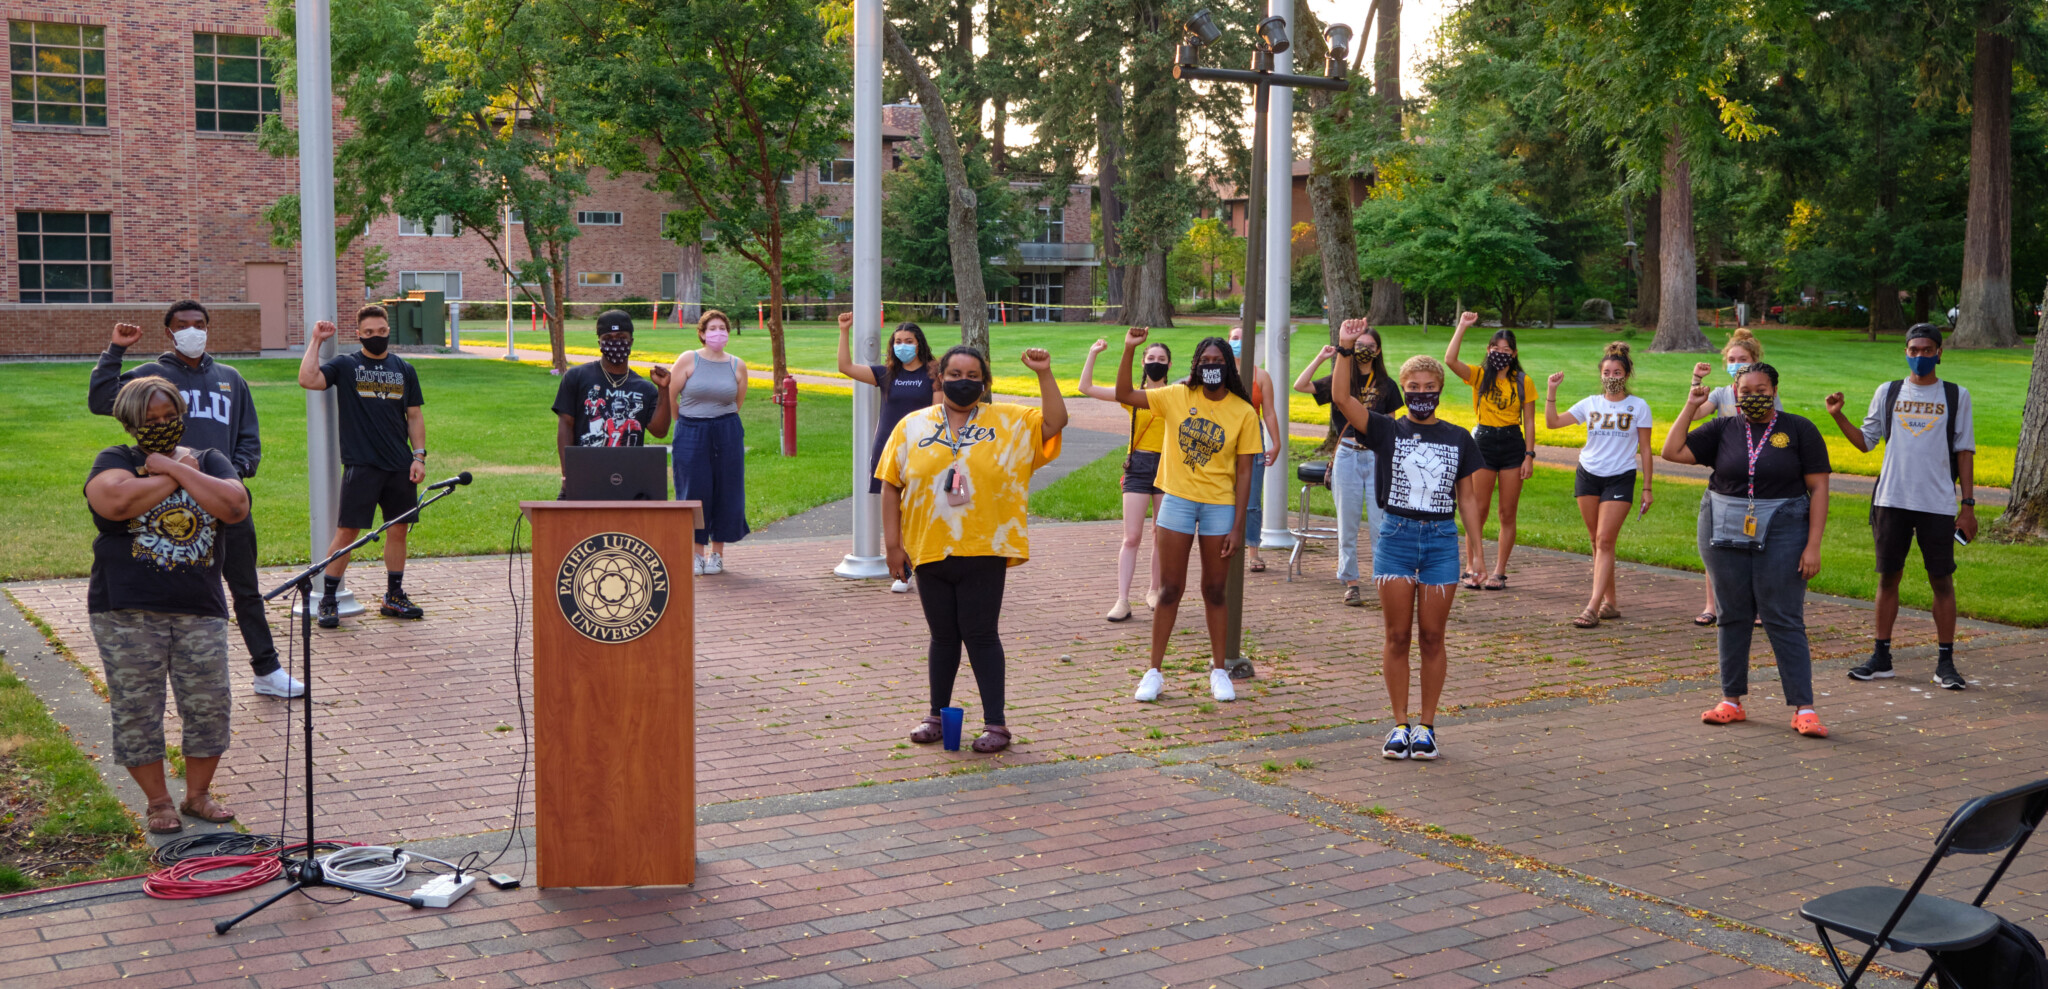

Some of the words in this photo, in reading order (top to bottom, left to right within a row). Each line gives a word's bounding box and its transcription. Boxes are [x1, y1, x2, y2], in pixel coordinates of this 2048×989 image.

[355, 368, 404, 385] LUTES
[894, 378, 923, 388] tommy
[605, 388, 644, 400] MIKE
[1894, 400, 1945, 415] LUTES
[1588, 411, 1633, 431] PLU
[559, 540, 596, 595] PACIFIC
[602, 535, 667, 592] LUTHERAN
[570, 606, 658, 640] UNIVERSITY
